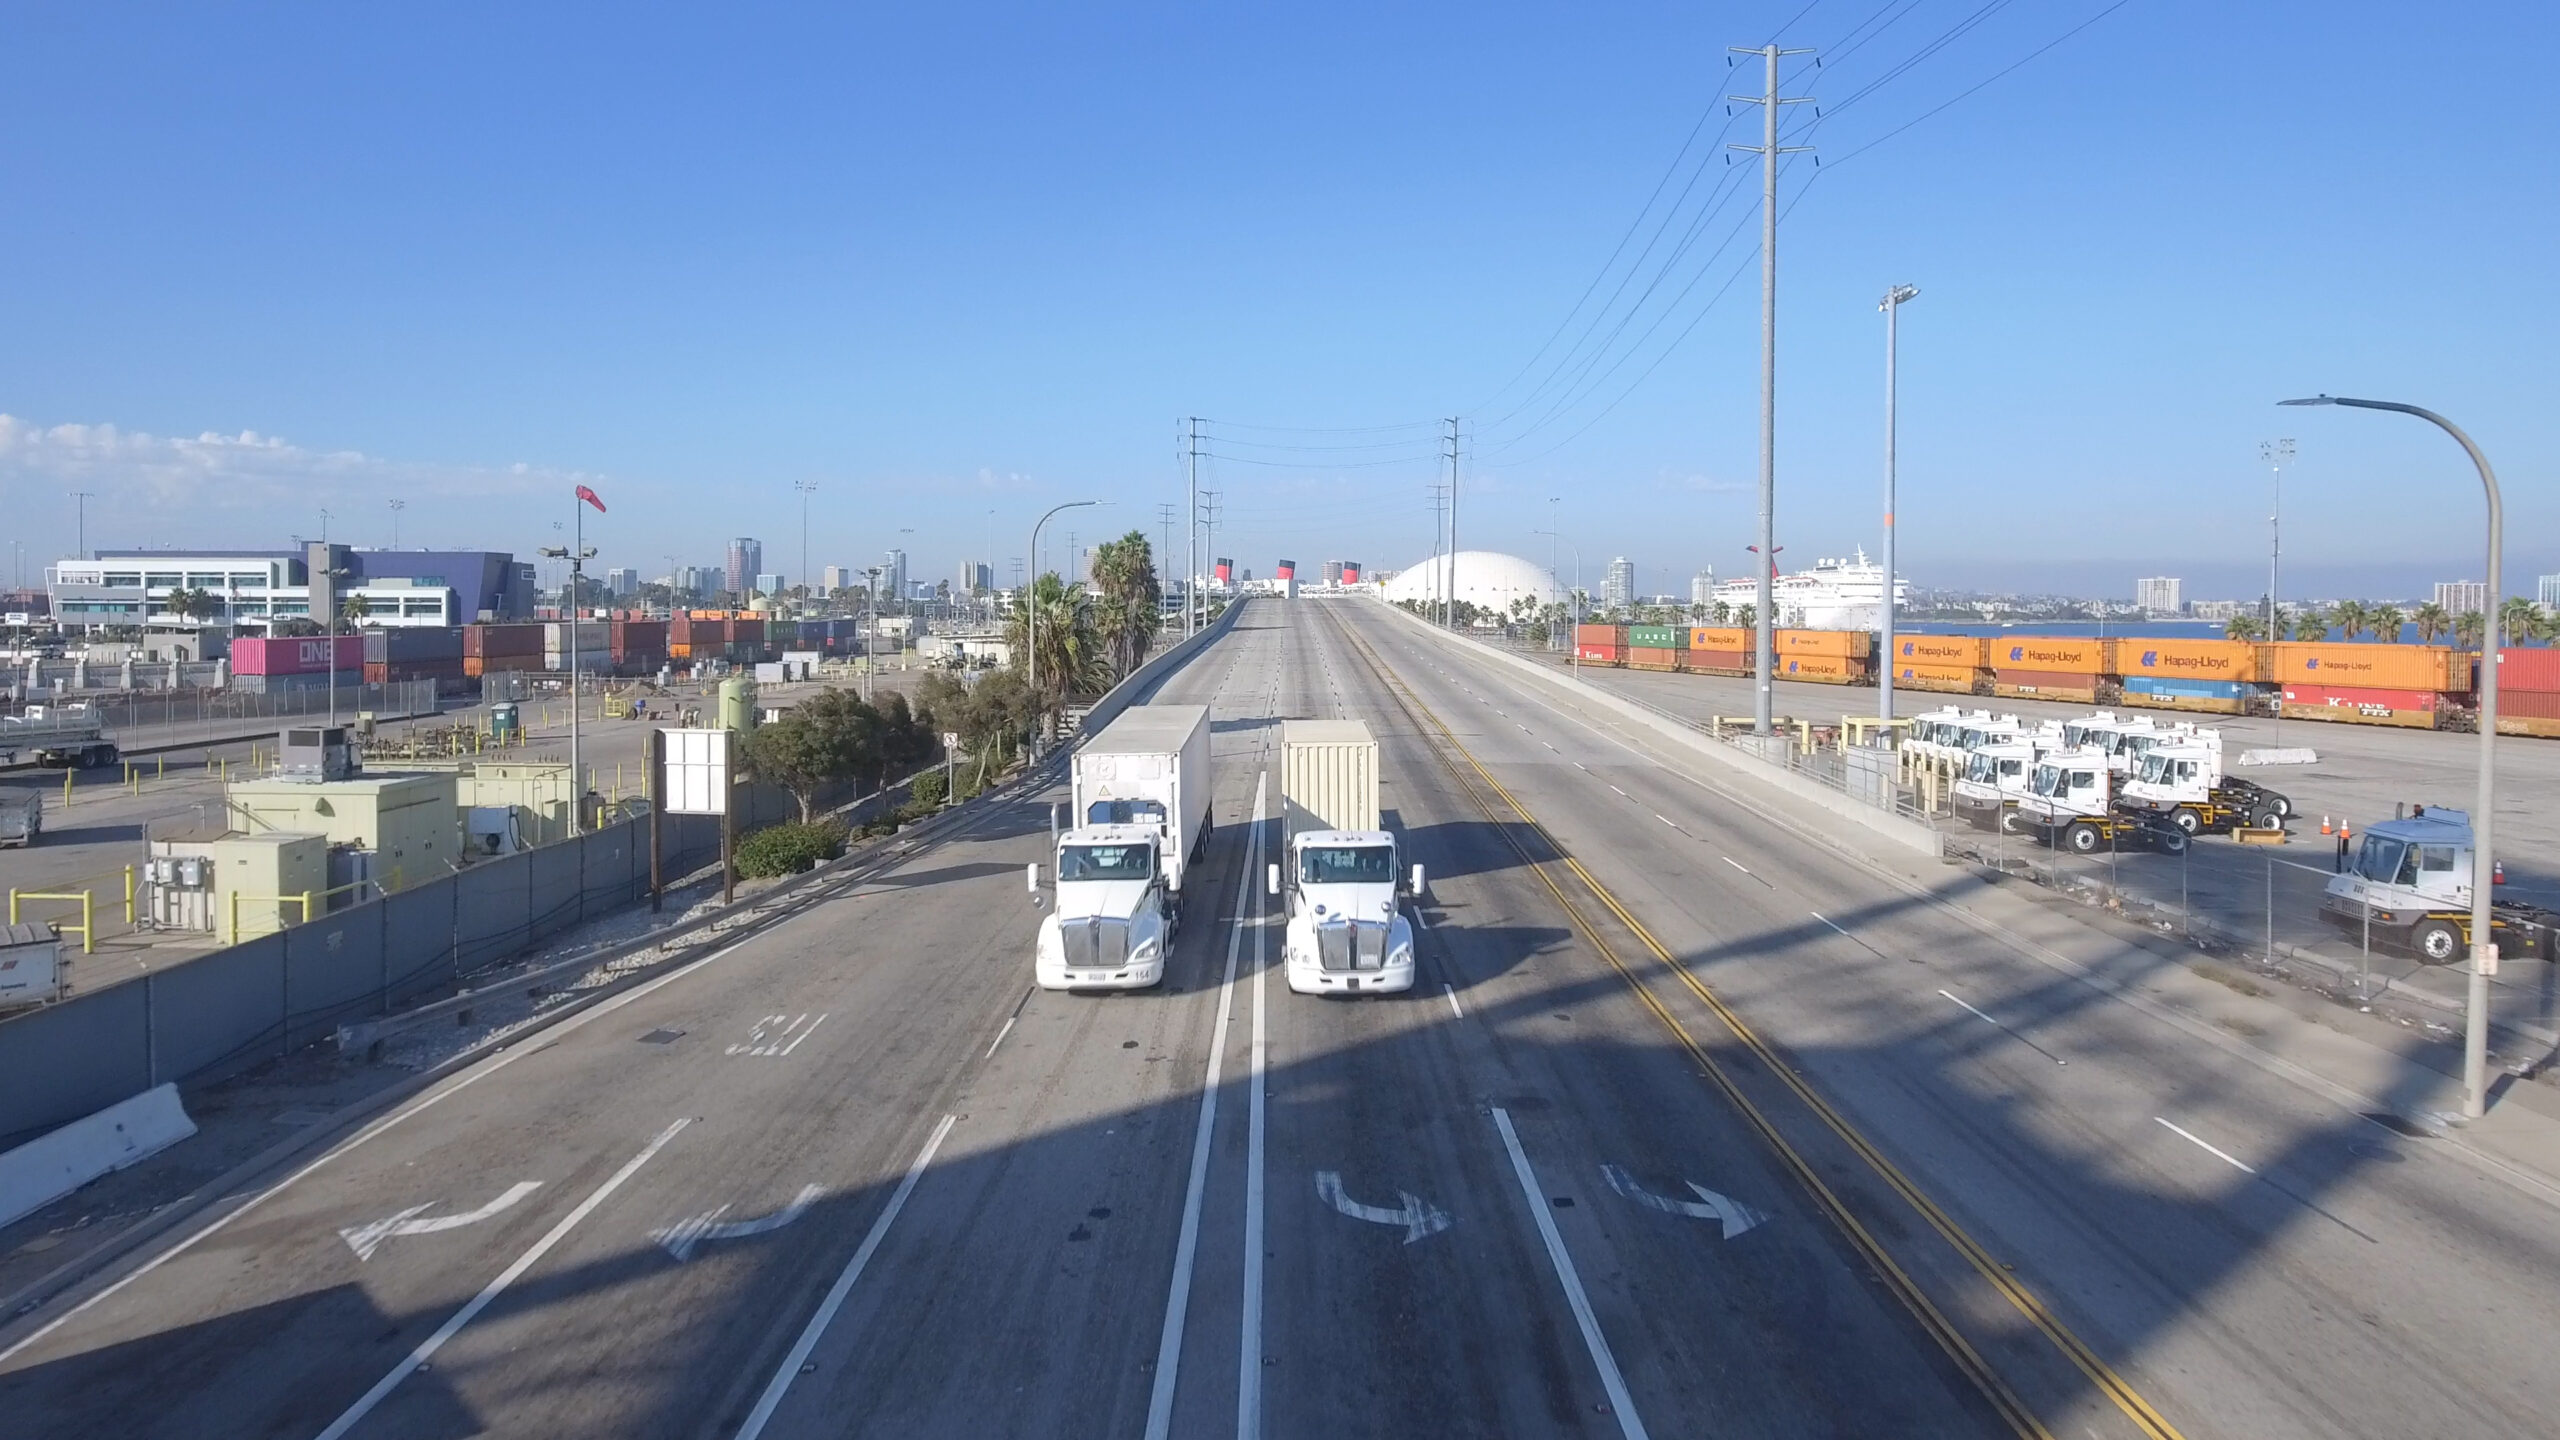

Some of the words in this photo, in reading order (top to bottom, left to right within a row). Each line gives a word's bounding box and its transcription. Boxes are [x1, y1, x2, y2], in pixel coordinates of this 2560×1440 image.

[1707, 635, 1737, 645] Hapag-Lloyd
[299, 640, 331, 662] ONE
[1918, 645, 1962, 657] Hapag-Lloyd
[2028, 650, 2082, 664] Hapag-Lloyd
[2164, 655, 2229, 670] Hapag-Lloyd
[2324, 661, 2372, 671] Hapag-Lloyd
[1802, 664, 1837, 674] Hapag-Lloyd
[2151, 694, 2174, 702] TTX
[2360, 708, 2391, 717] TTX
[1135, 970, 1149, 981] 154
